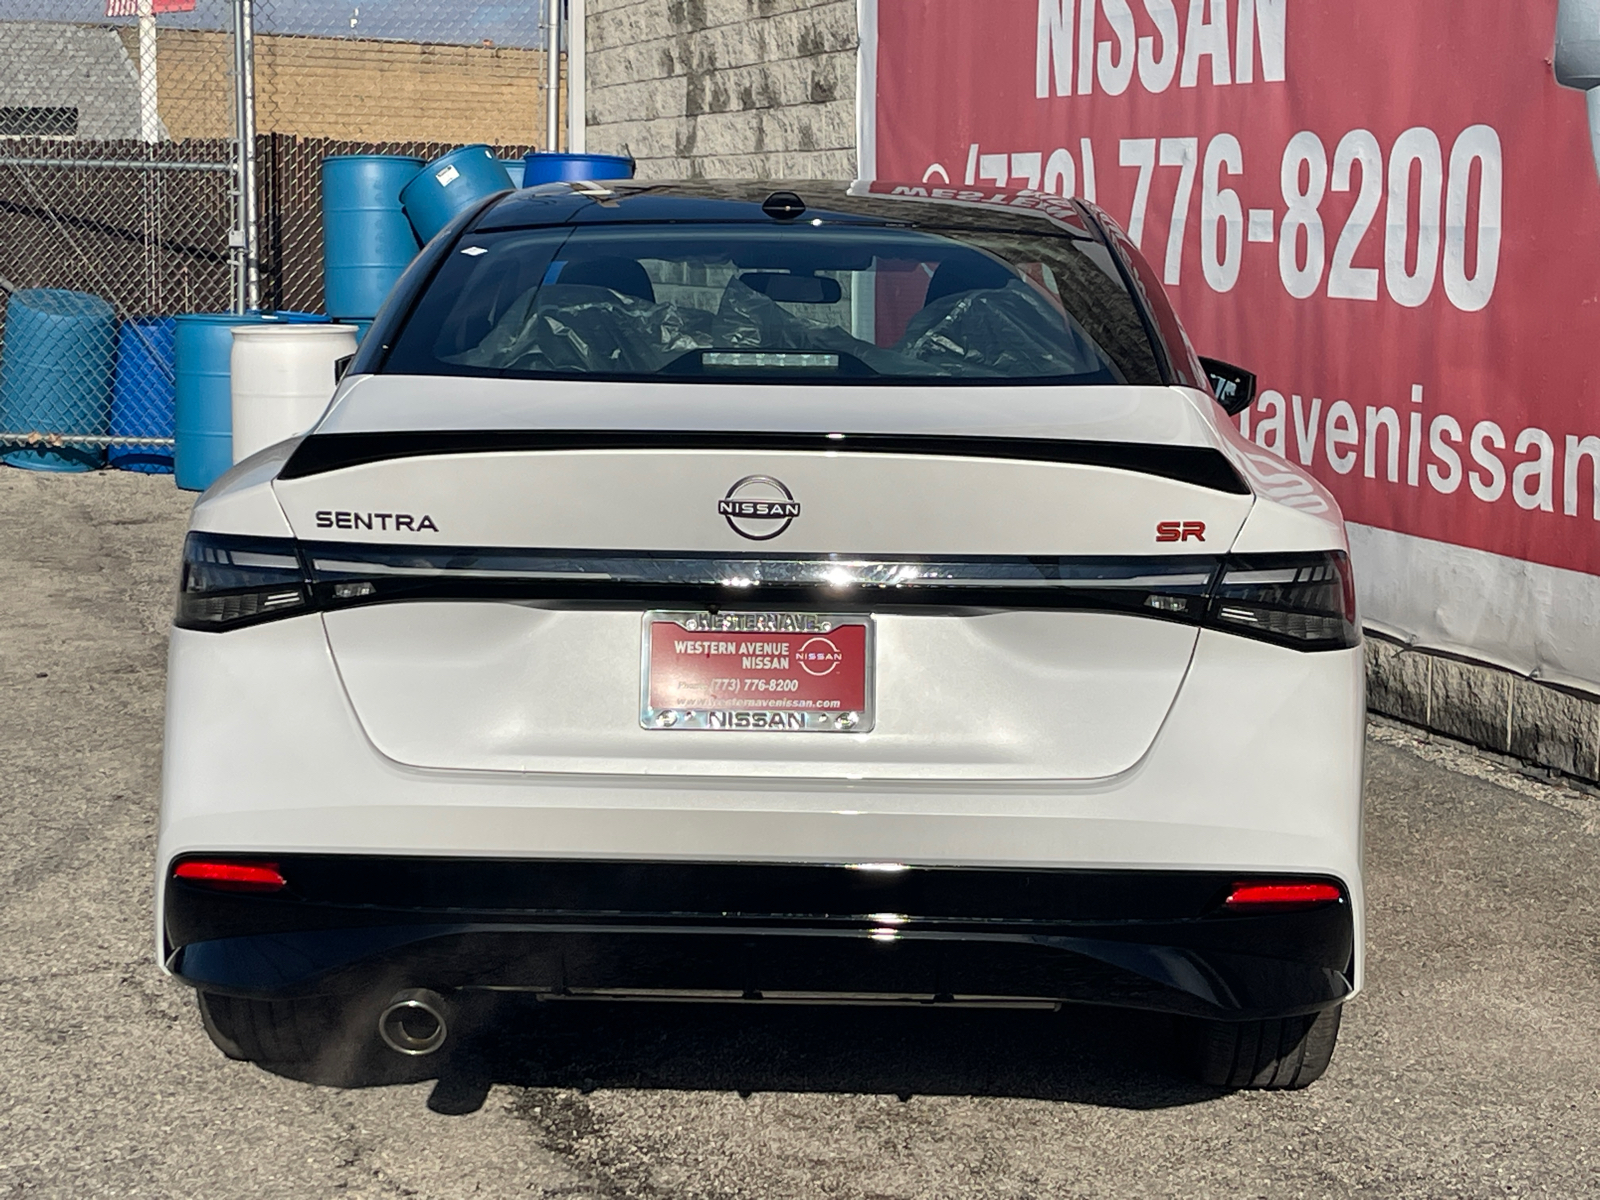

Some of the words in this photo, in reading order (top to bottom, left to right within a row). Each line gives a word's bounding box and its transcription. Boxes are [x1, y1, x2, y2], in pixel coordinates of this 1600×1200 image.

[1036, 0, 1286, 99] NISSAN
[1118, 124, 1502, 311] 776-8200
[1239, 384, 1600, 522] avenissan
[720, 502, 799, 515] NISSAN
[315, 510, 439, 532] SENTRA
[1155, 521, 1206, 542] SR
[674, 640, 735, 655] WESTERN
[738, 642, 790, 656] AVENUE
[795, 652, 842, 661] NISSAN
[742, 656, 790, 670] NISSAN
[711, 678, 741, 694] (773)
[744, 679, 799, 692] 776-8200
[708, 711, 806, 728] NISSAN
